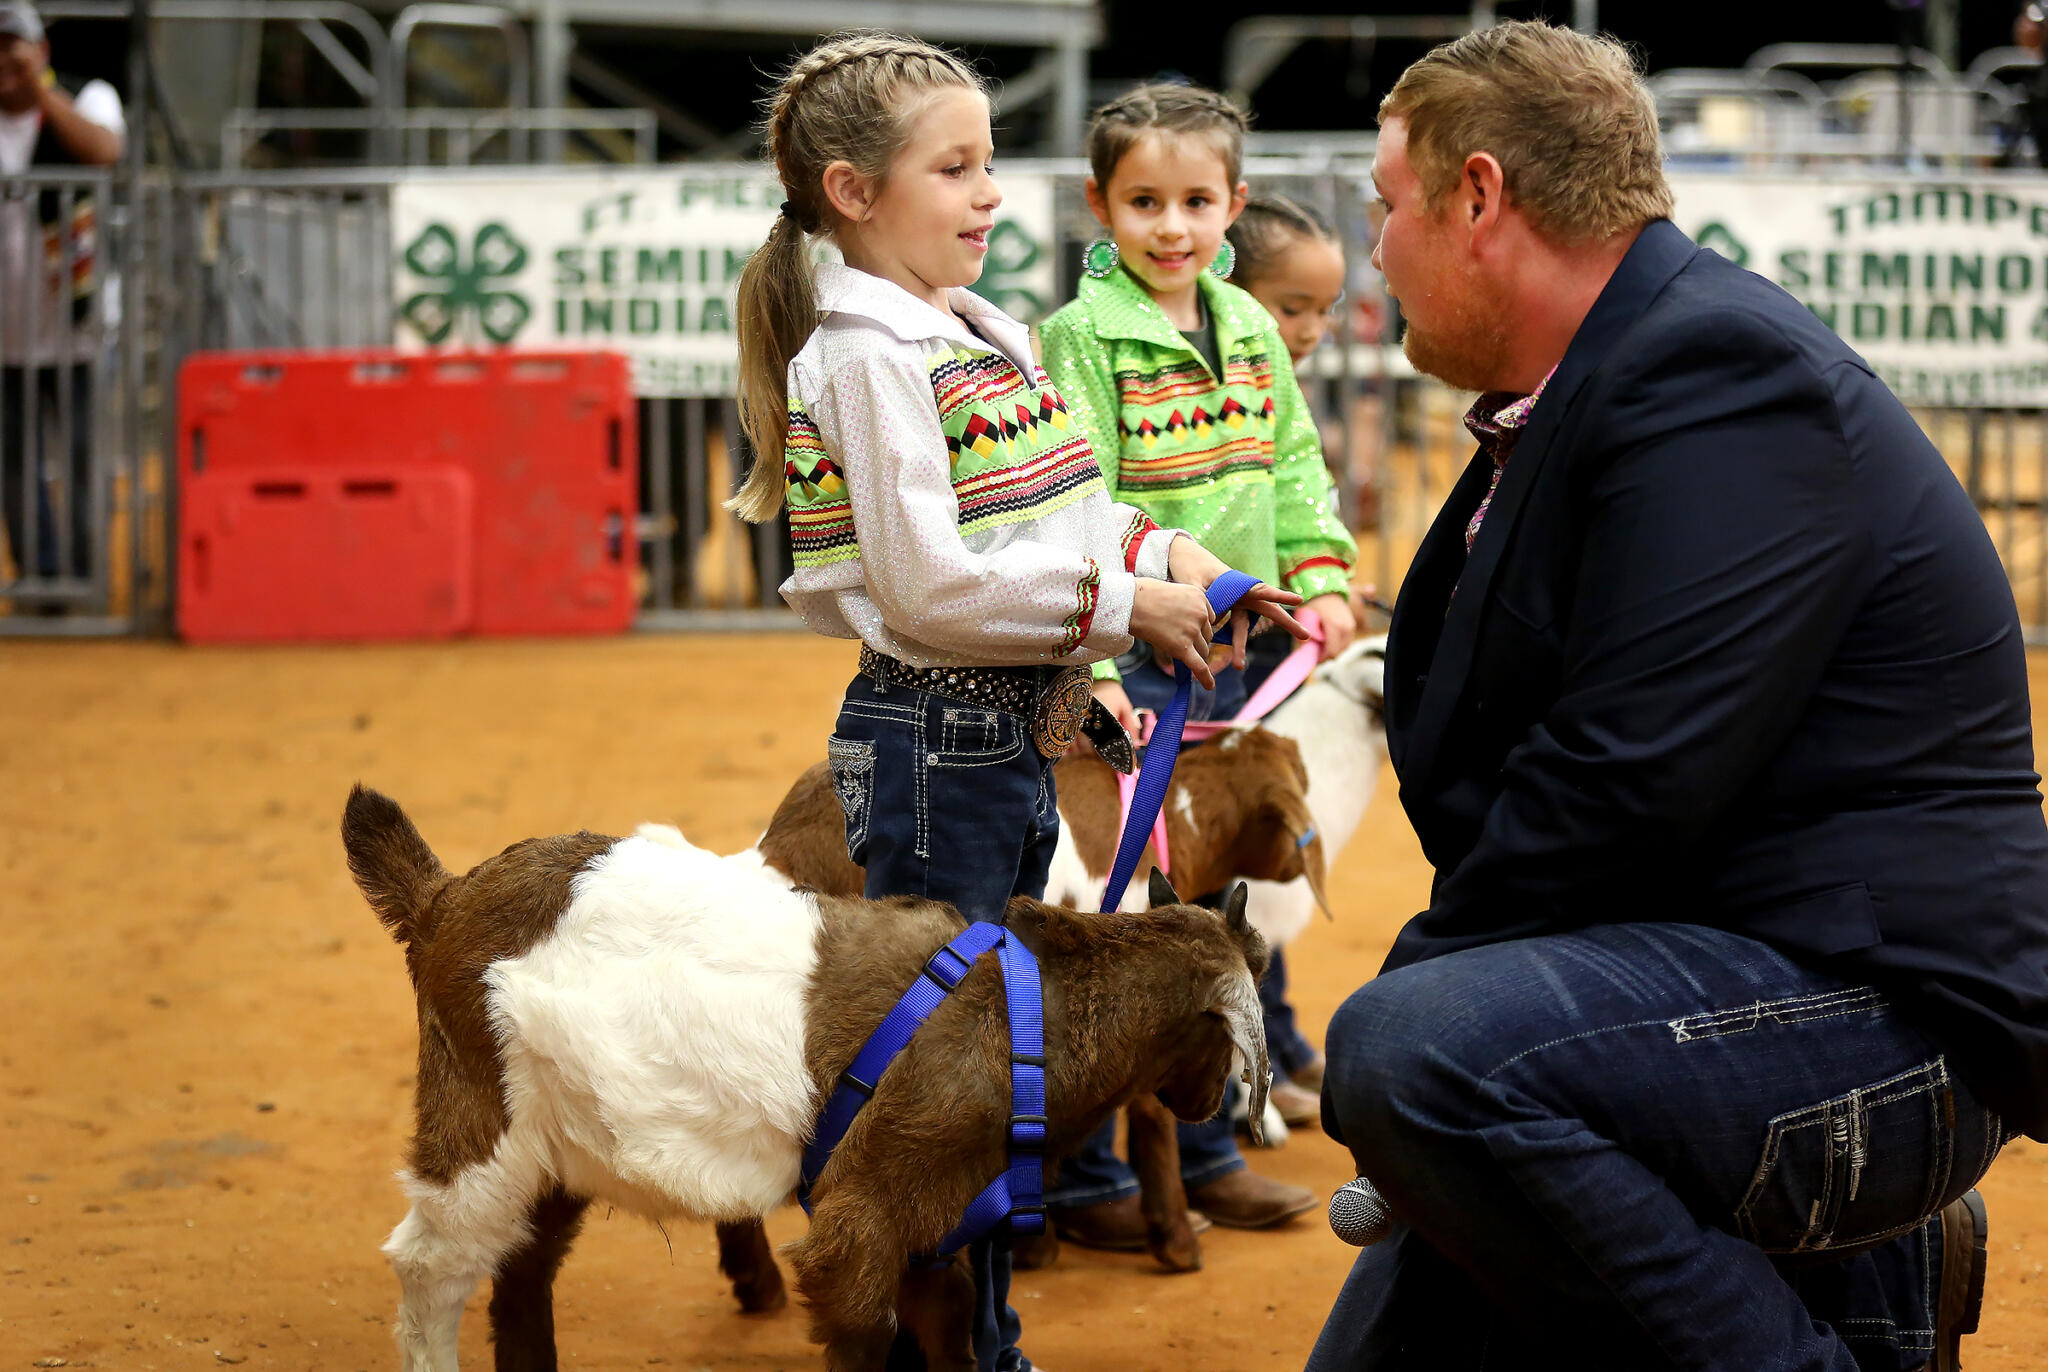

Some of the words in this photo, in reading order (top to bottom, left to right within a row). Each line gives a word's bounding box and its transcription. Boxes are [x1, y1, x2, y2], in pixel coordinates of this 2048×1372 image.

[553, 248, 755, 284] SEMIN
[1779, 252, 2048, 291] SEMINO
[557, 299, 732, 334] INDIA
[1806, 303, 2005, 341] NDIAN
